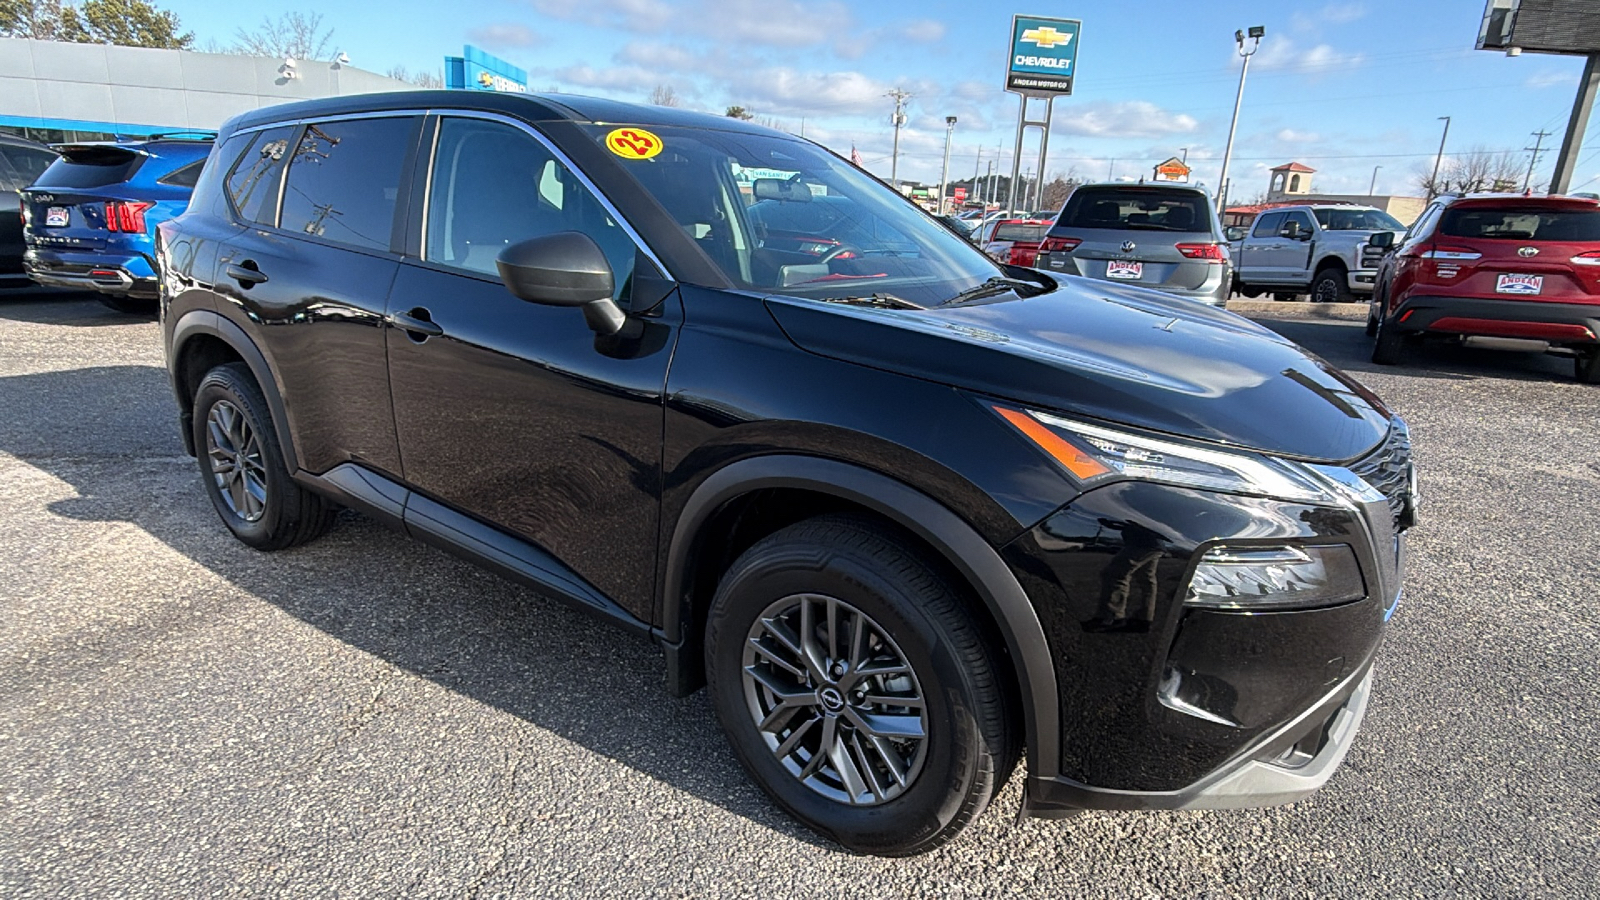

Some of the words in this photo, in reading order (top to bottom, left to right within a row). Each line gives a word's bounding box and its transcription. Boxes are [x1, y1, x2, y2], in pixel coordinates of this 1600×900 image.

[1015, 55, 1071, 69] CHEVROLET
[1013, 78, 1037, 87] ANDEAN
[1038, 80, 1057, 88] MOTOR
[614, 130, 653, 155] 23
[1500, 276, 1540, 289] ANDEAN
